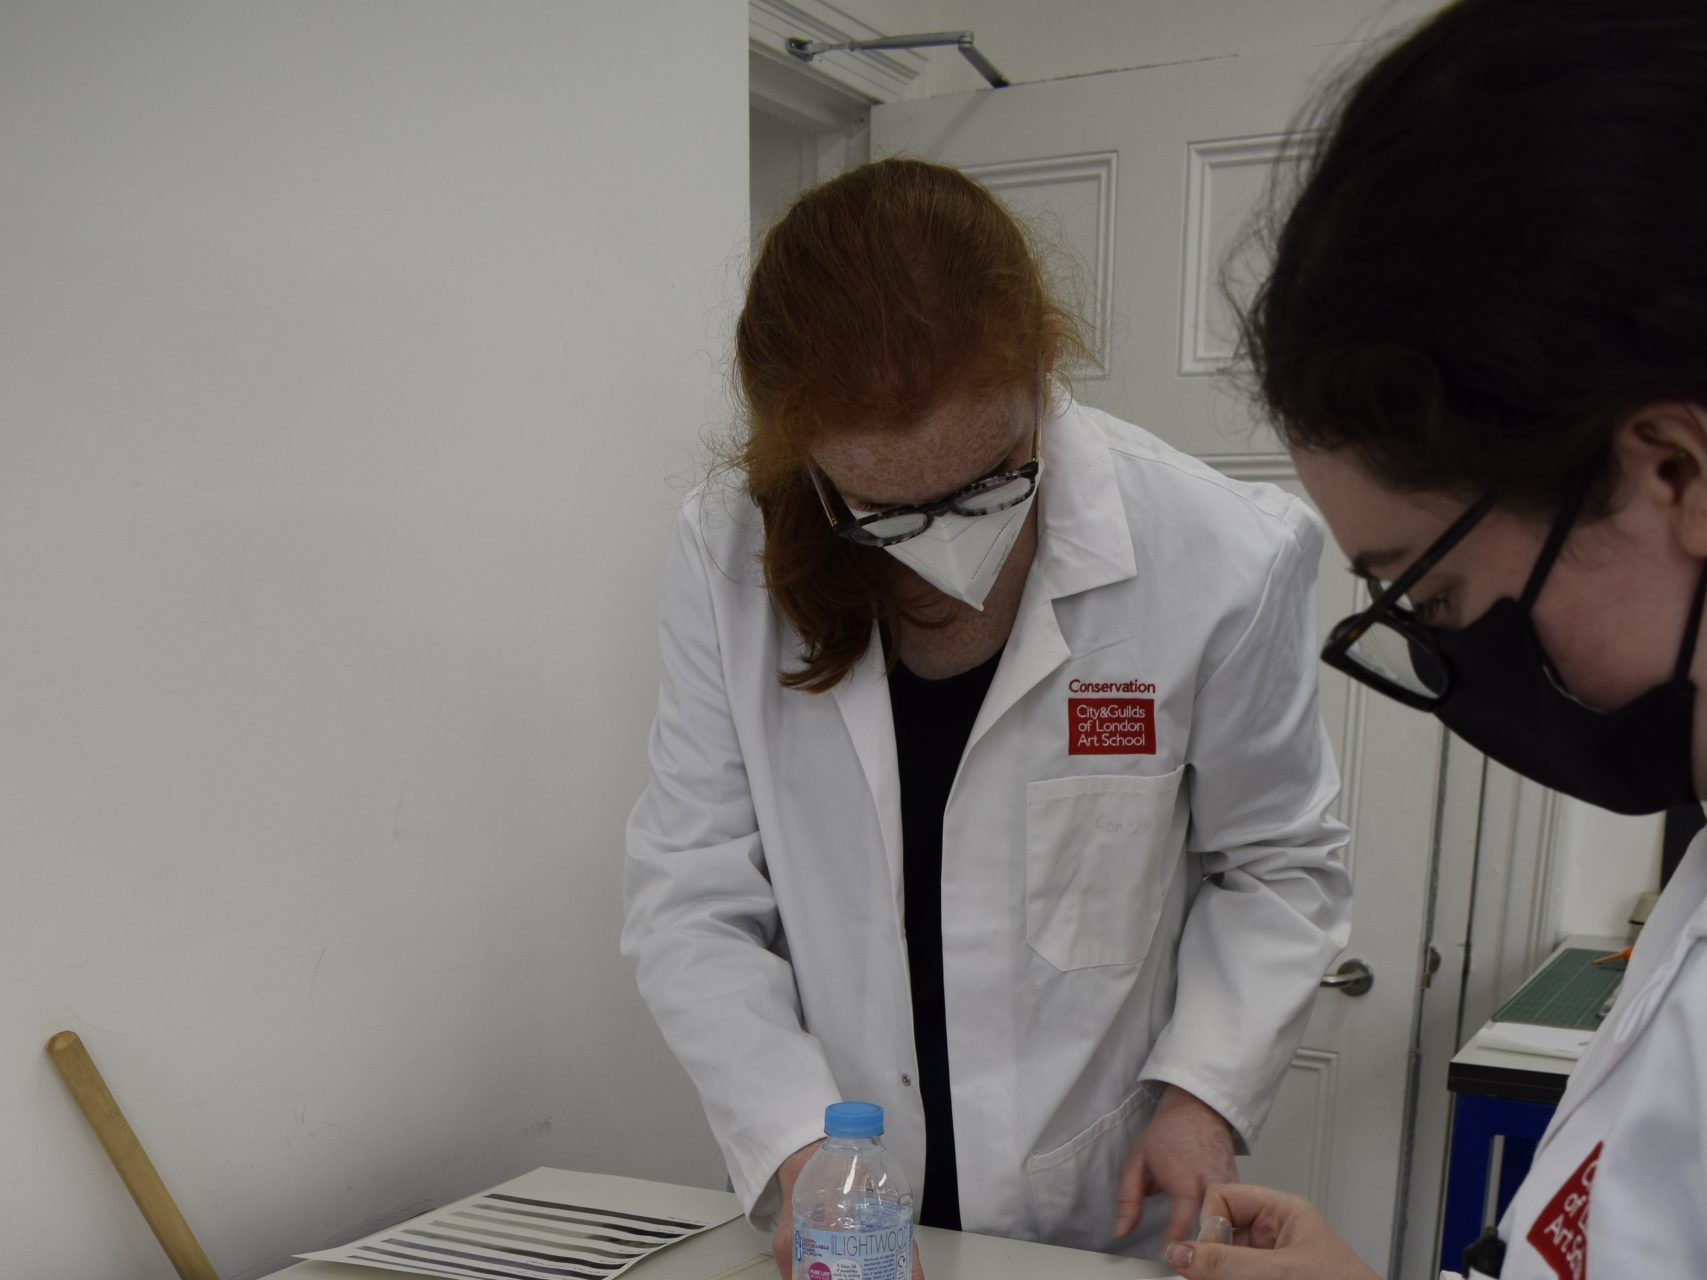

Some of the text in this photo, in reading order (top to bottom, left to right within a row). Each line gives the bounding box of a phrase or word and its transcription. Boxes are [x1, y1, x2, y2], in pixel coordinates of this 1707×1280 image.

[1068, 679, 1156, 694] Conservation
[1076, 704, 1146, 720] City&Guilds
[1078, 719, 1145, 732] of London
[1077, 733, 1146, 747] Art School
